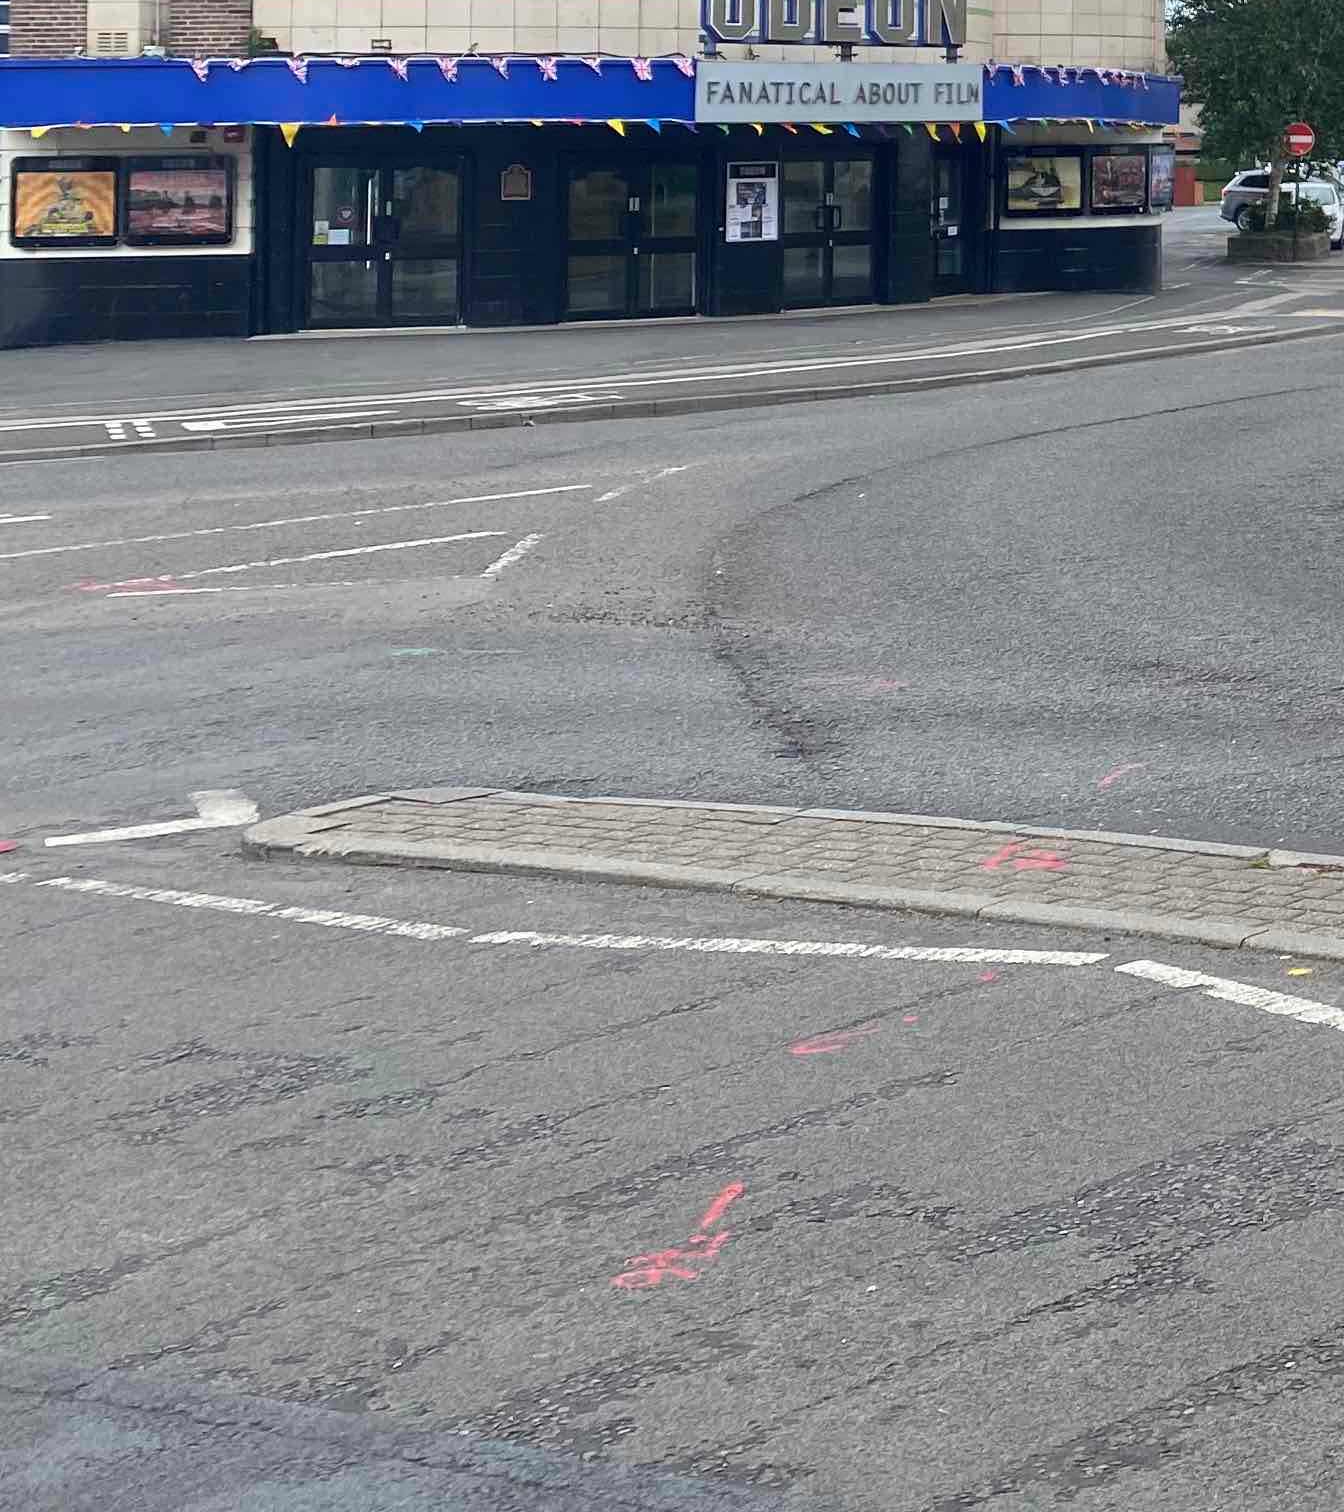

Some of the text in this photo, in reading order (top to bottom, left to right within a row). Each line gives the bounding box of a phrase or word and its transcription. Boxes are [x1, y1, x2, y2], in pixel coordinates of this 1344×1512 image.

[706, 80, 980, 106] FANATICAL ABOUT FILM
